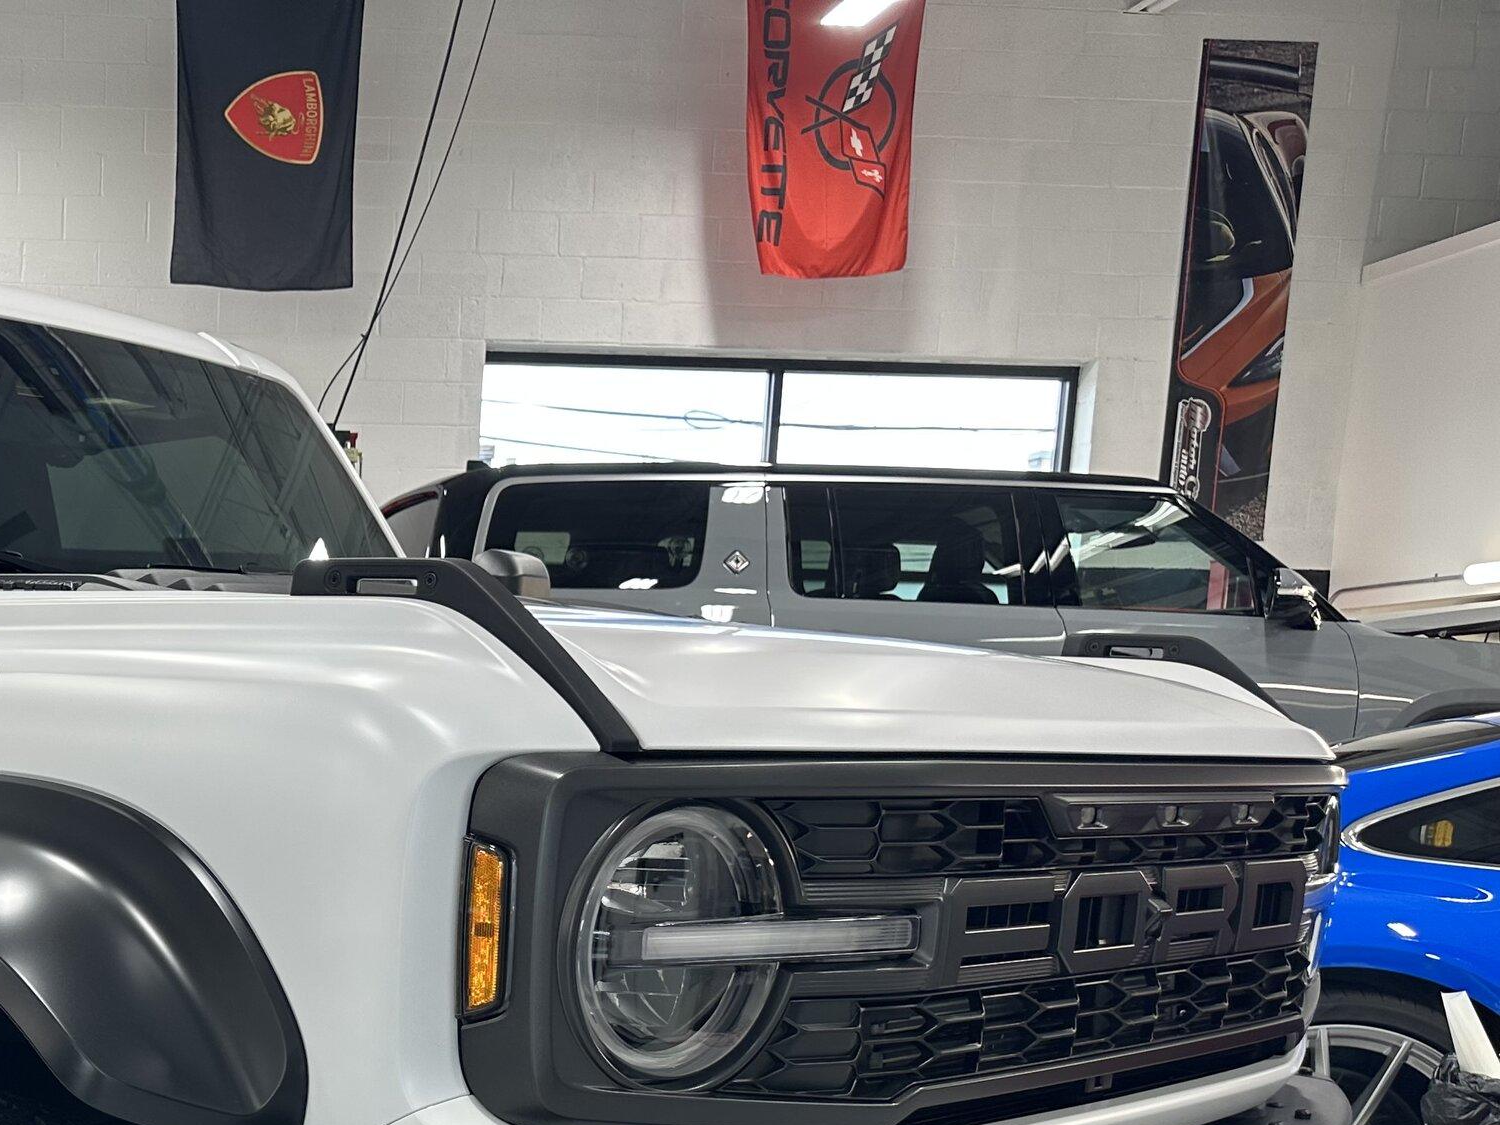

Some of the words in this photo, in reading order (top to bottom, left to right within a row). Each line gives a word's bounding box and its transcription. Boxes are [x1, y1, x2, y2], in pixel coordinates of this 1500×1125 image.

[302, 78, 318, 158] LAMBORGHINI
[756, 0, 792, 247] ORVETTE
[939, 857, 1308, 986] FORD
